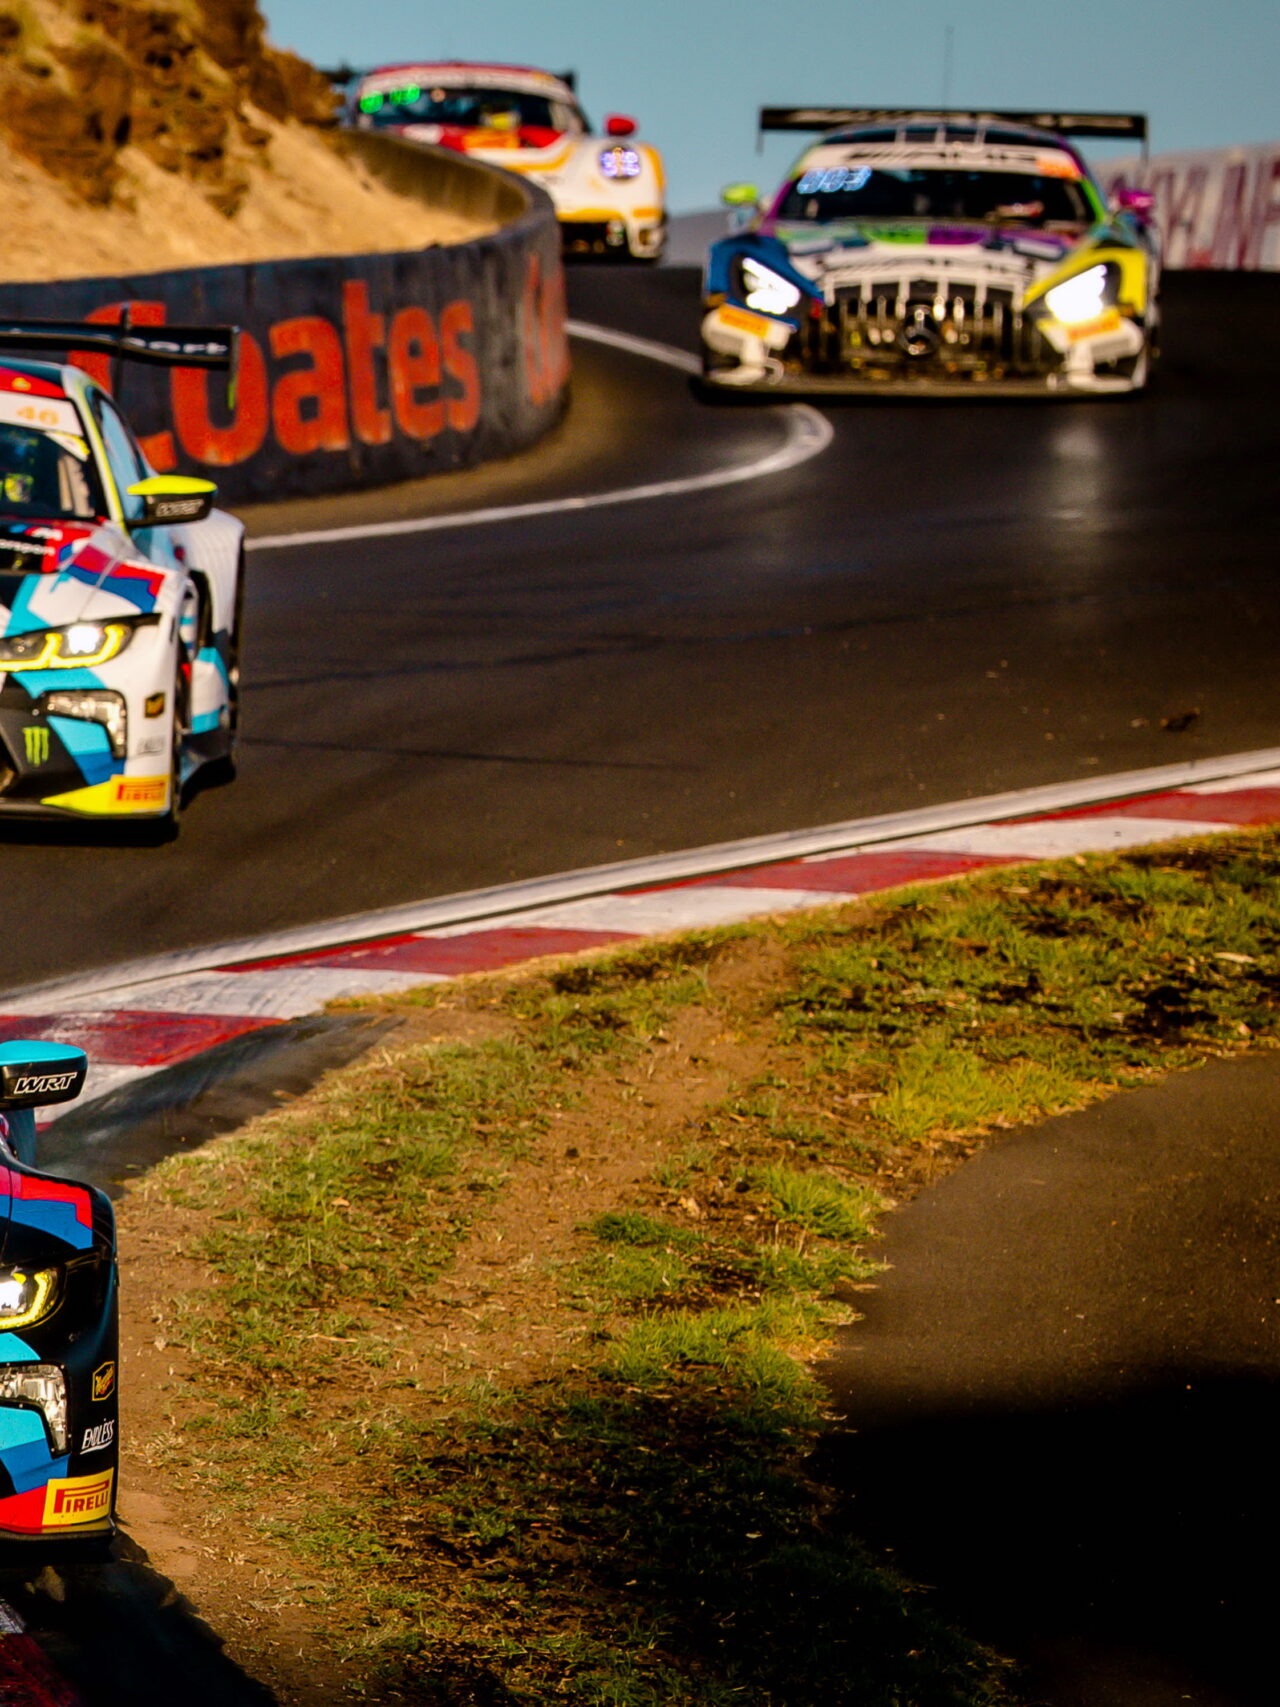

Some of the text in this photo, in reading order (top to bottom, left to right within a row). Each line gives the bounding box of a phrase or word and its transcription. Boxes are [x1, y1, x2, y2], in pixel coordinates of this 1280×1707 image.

[16, 405, 60, 426] 46
[13, 1071, 78, 1095] WRT
[81, 1419, 115, 1450] ENDLESS
[53, 1478, 110, 1514] PIRELLI
